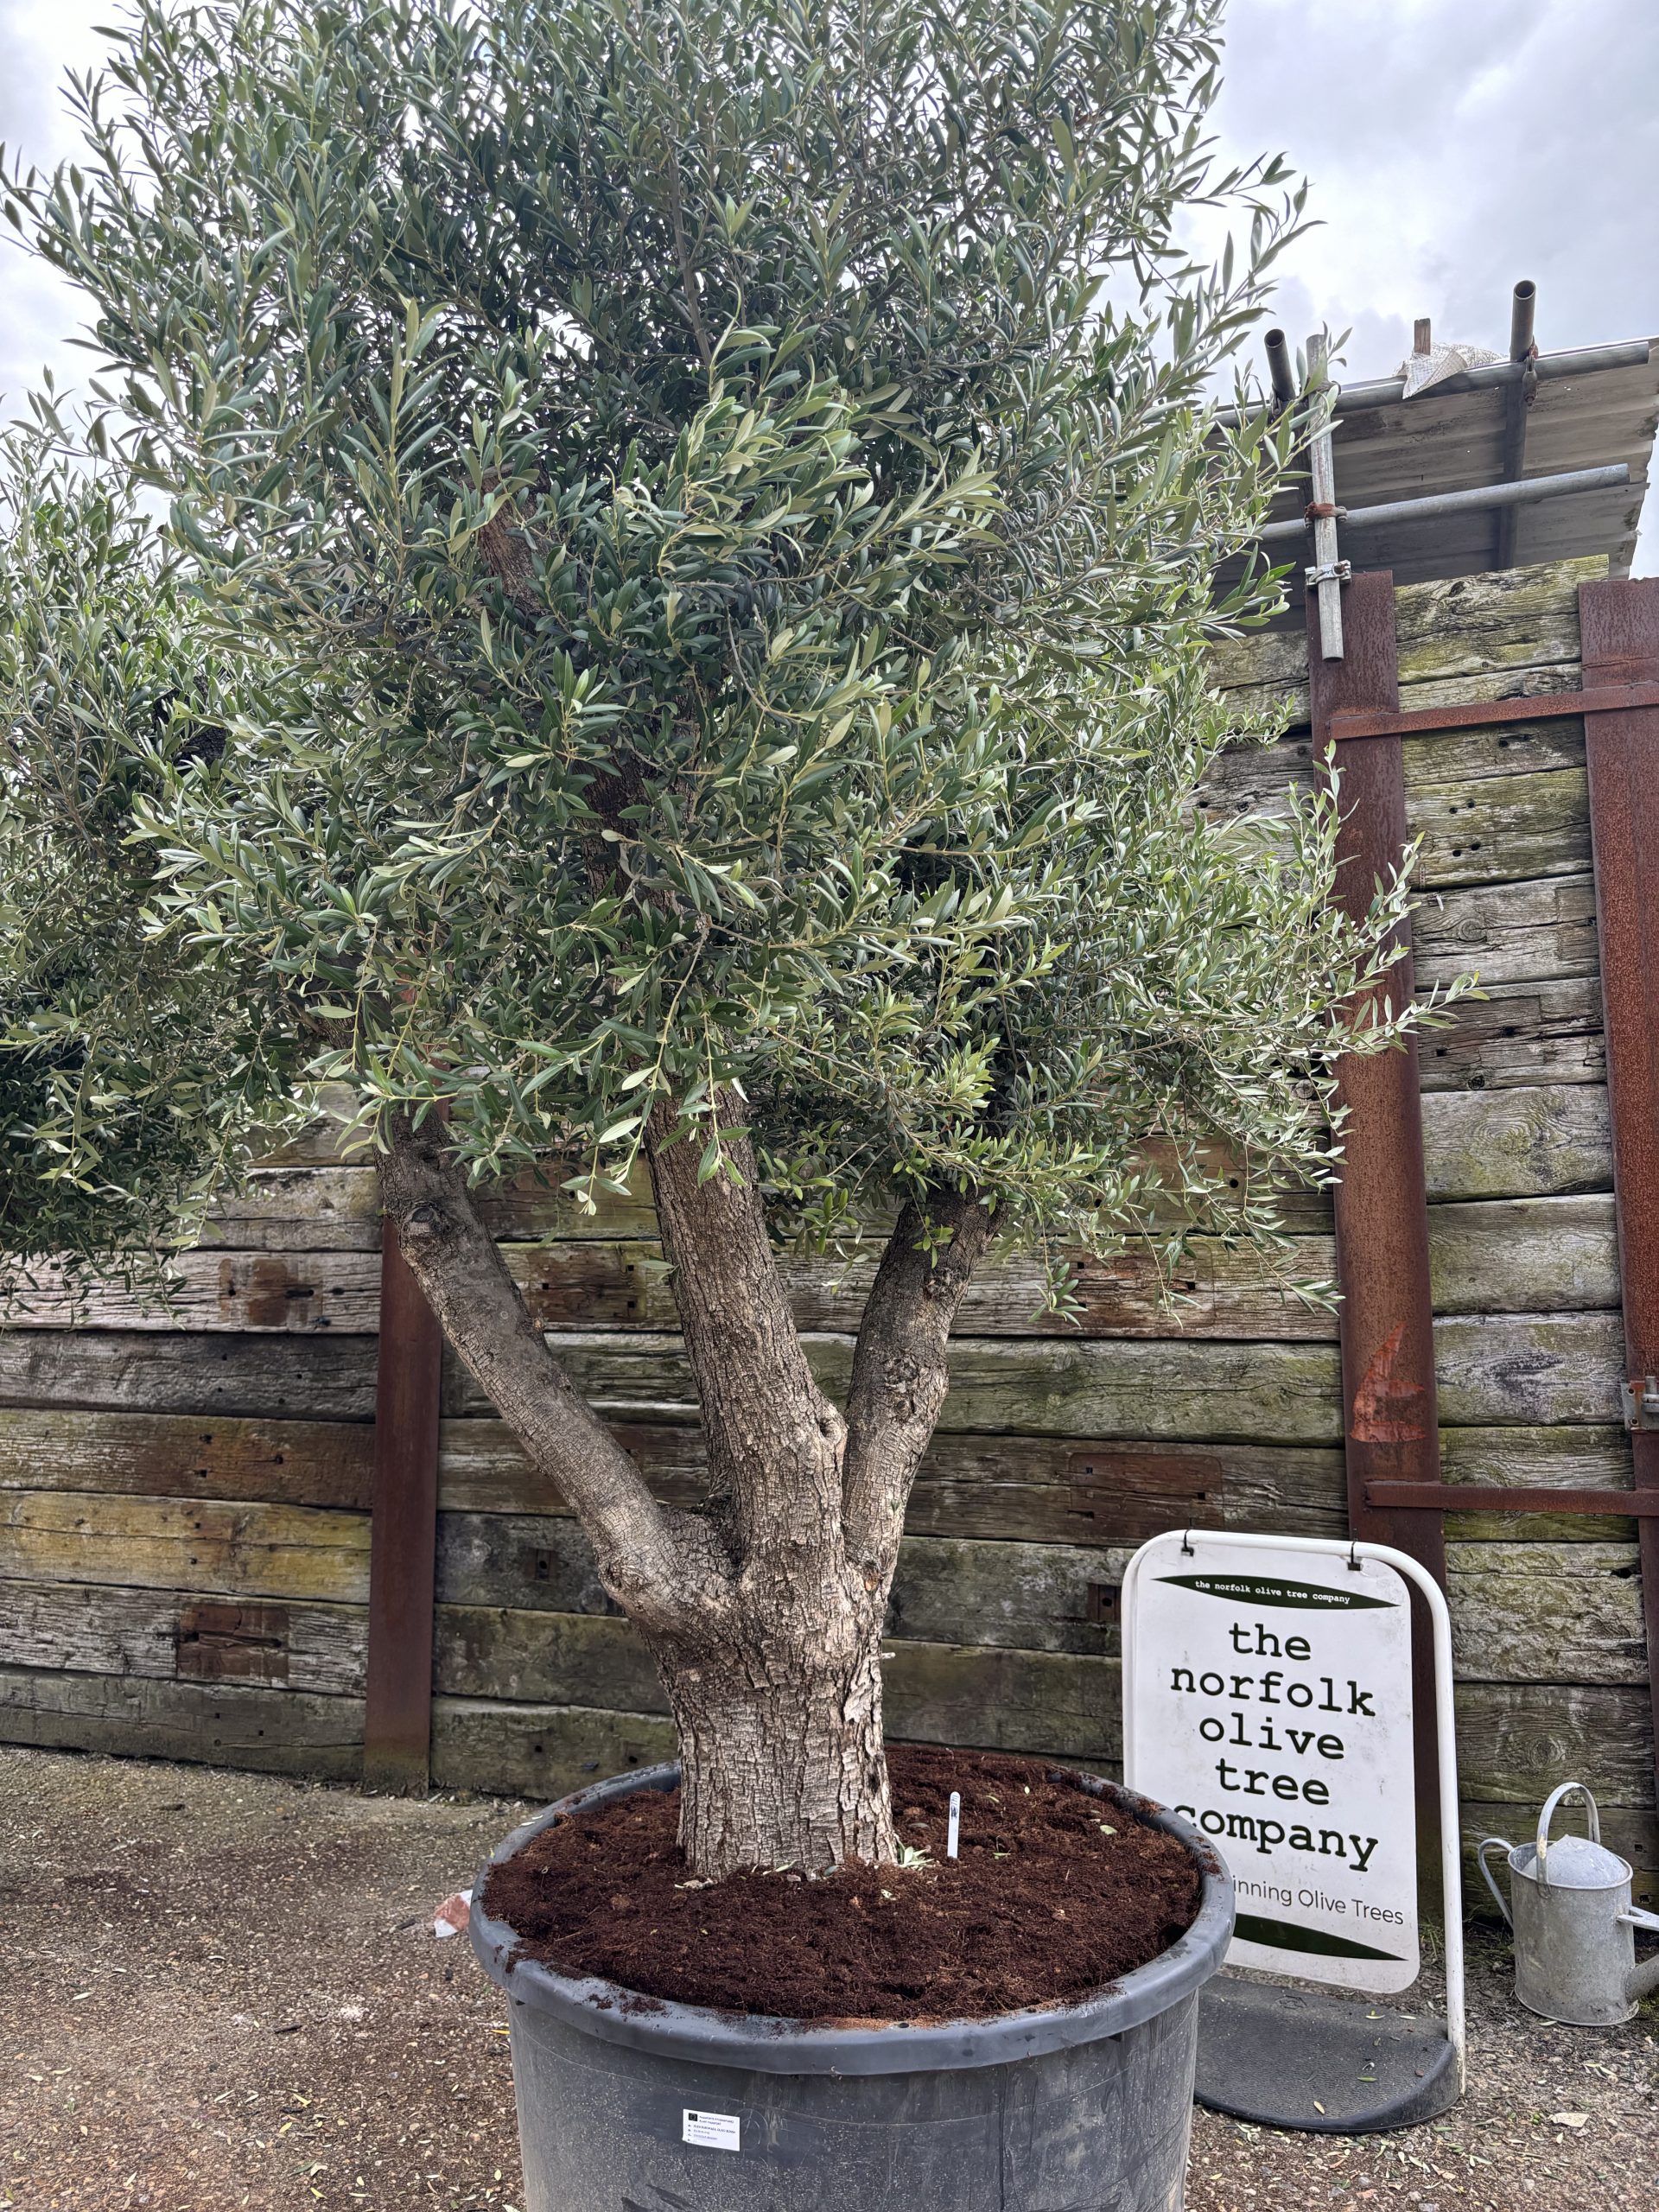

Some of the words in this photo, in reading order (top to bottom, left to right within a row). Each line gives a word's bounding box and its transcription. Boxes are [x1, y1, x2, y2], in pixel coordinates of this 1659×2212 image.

[1195, 1580, 1211, 1589] the
[1214, 1583, 1251, 1593] norfolk
[1255, 1586, 1282, 1596] olive
[1286, 1590, 1308, 1599] tree
[1312, 1592, 1351, 1605] company
[1228, 1622, 1311, 1661] the
[1170, 1668, 1376, 1717] norfolk
[1199, 1712, 1344, 1760] olive
[1215, 1758, 1330, 1806] tree
[1232, 1874, 1293, 1907] inning
[1298, 1889, 1346, 1914] Olive
[1351, 1898, 1404, 1925] Trees
